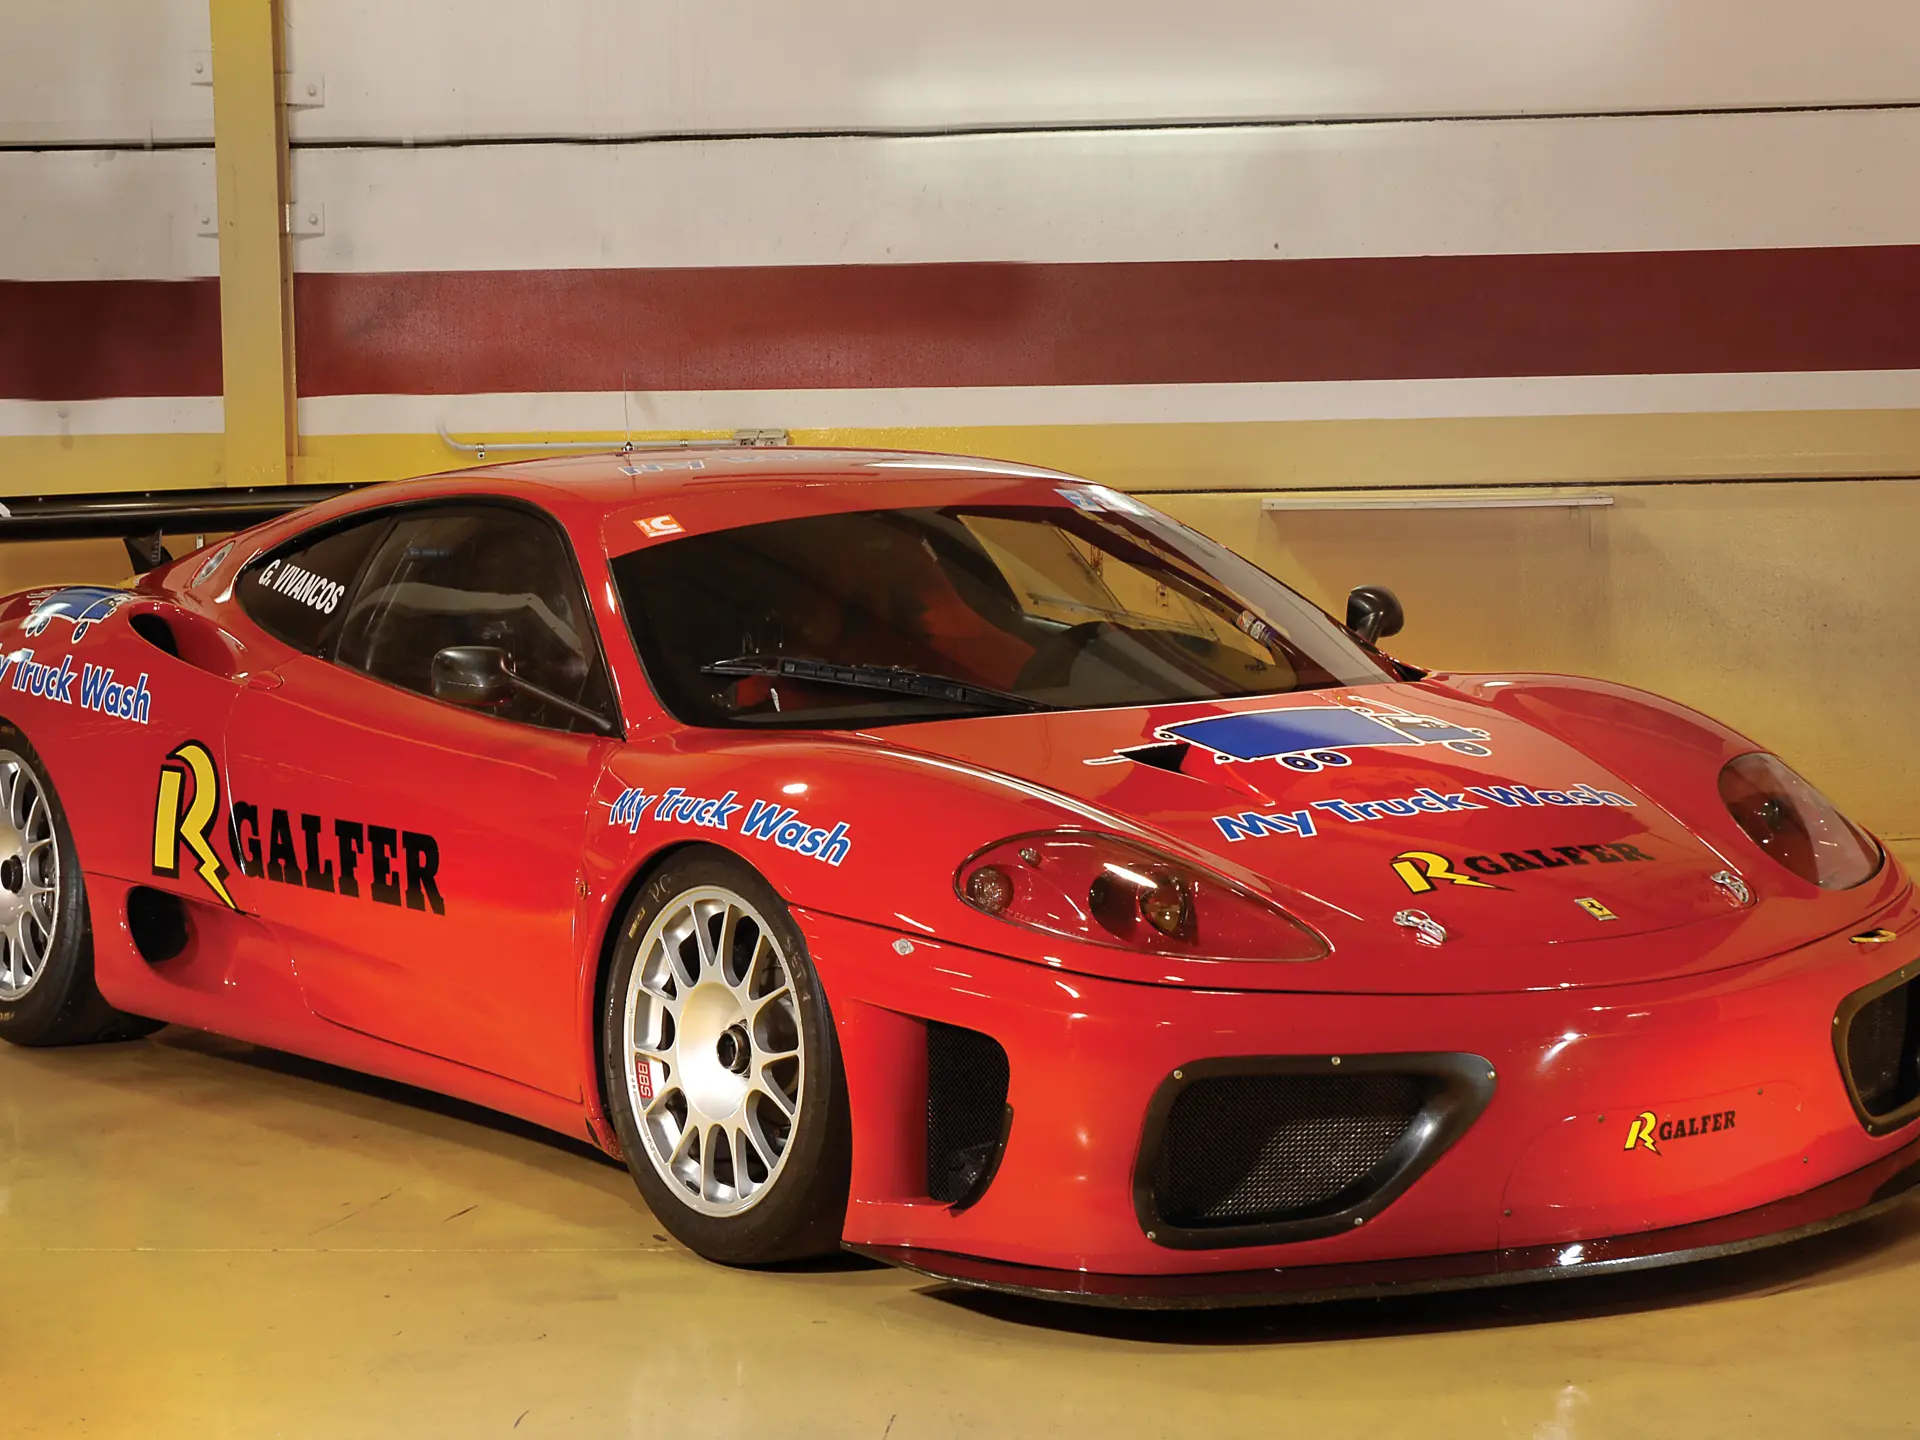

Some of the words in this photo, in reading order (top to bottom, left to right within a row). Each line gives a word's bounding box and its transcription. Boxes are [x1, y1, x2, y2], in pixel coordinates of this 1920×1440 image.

[258, 559, 281, 587] G.
[272, 563, 345, 615] VIVANCOS
[9, 647, 78, 705] Truck
[80, 662, 151, 725] Wash
[608, 788, 658, 834] My
[654, 788, 743, 830] Truck
[740, 799, 851, 867] Wash
[1212, 809, 1319, 843] My
[1313, 787, 1488, 824] Truck
[1464, 783, 1638, 808] Wash
[228, 801, 446, 916] GALFER
[1463, 841, 1656, 876] GALFER
[637, 1061, 652, 1098] BBS
[1658, 1110, 1736, 1141] GALFER
